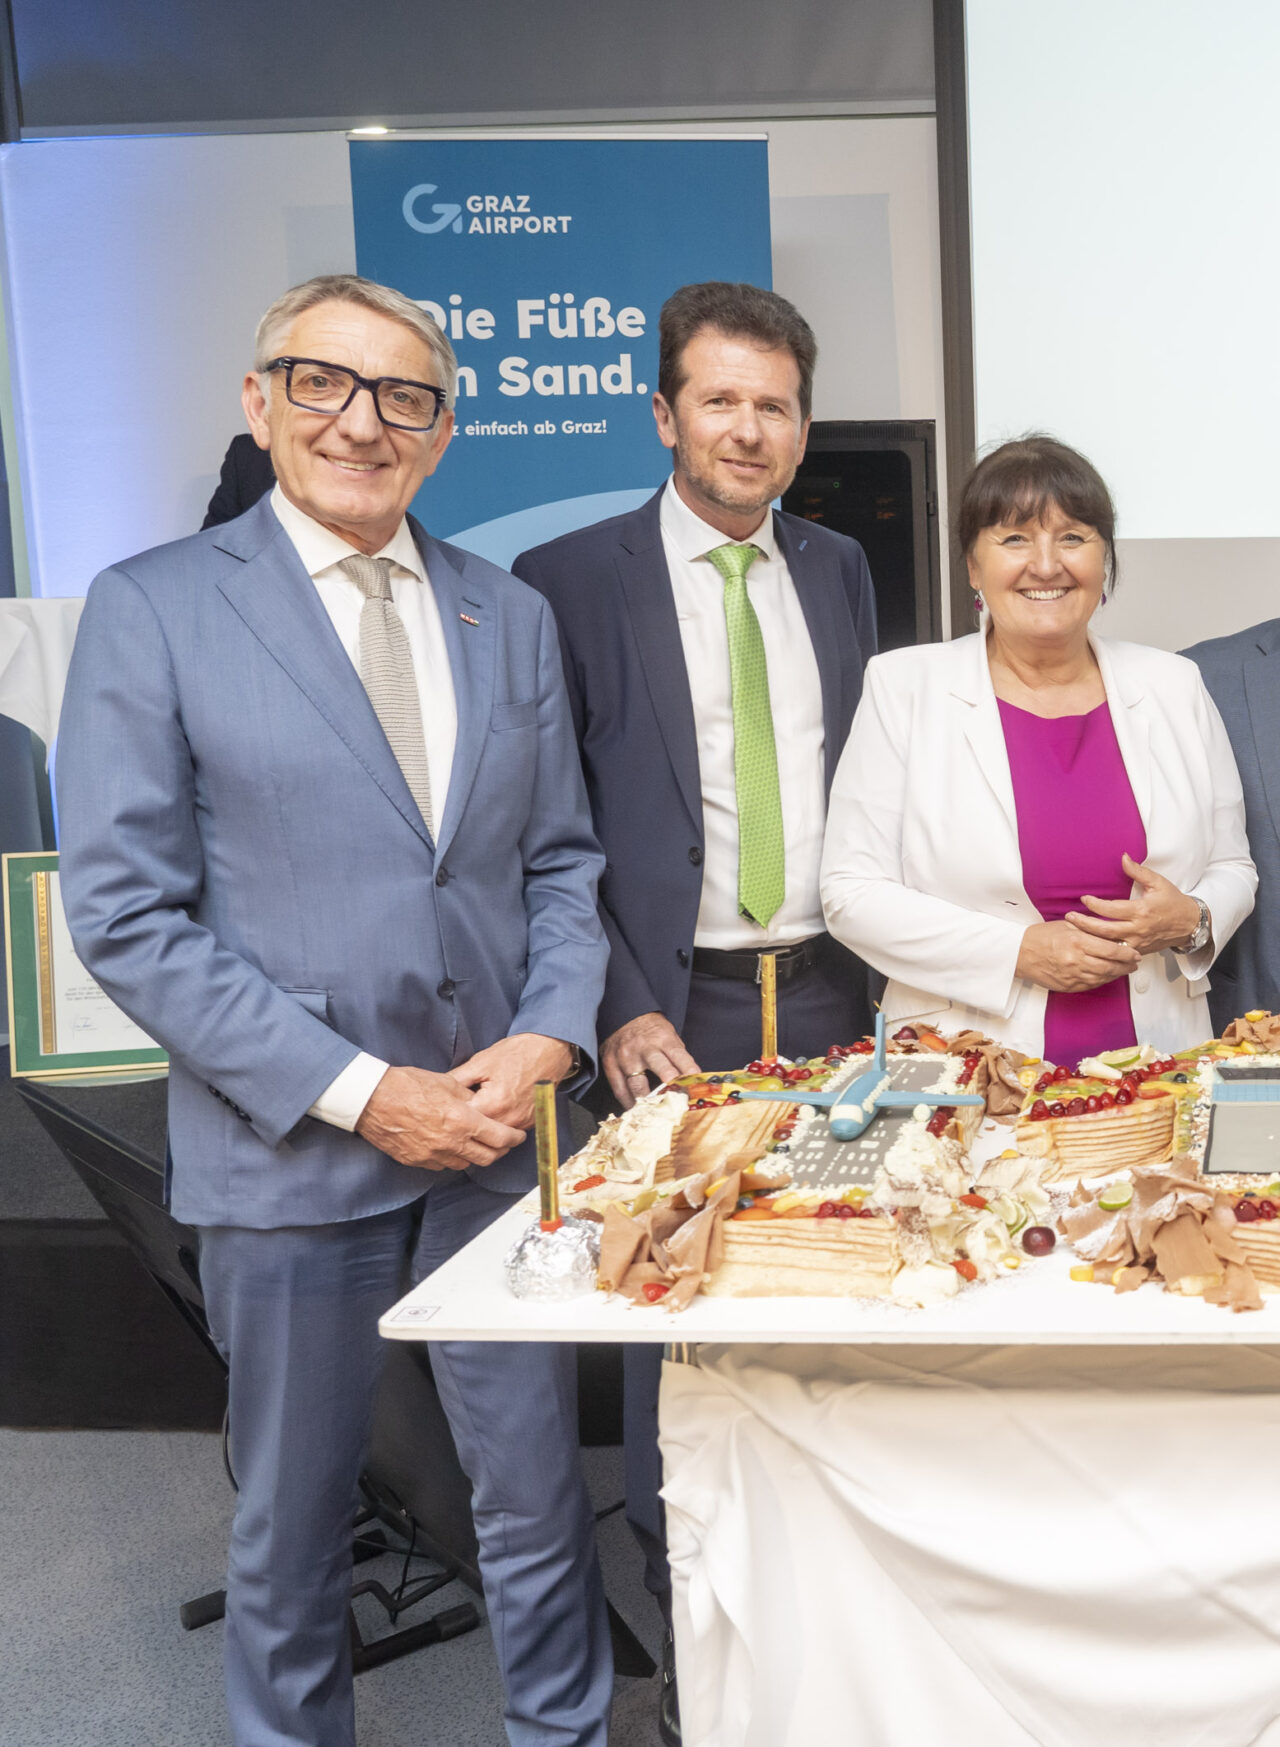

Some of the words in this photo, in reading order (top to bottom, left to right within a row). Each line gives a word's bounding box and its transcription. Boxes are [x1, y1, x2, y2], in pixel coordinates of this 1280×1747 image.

[466, 195, 531, 213] GRAZ
[468, 216, 572, 234] AIRPORT
[517, 293, 646, 339] Füße
[498, 353, 648, 397] Sand.
[465, 420, 528, 436] einfach
[534, 420, 556, 435] ab
[561, 419, 607, 434] Graz!
